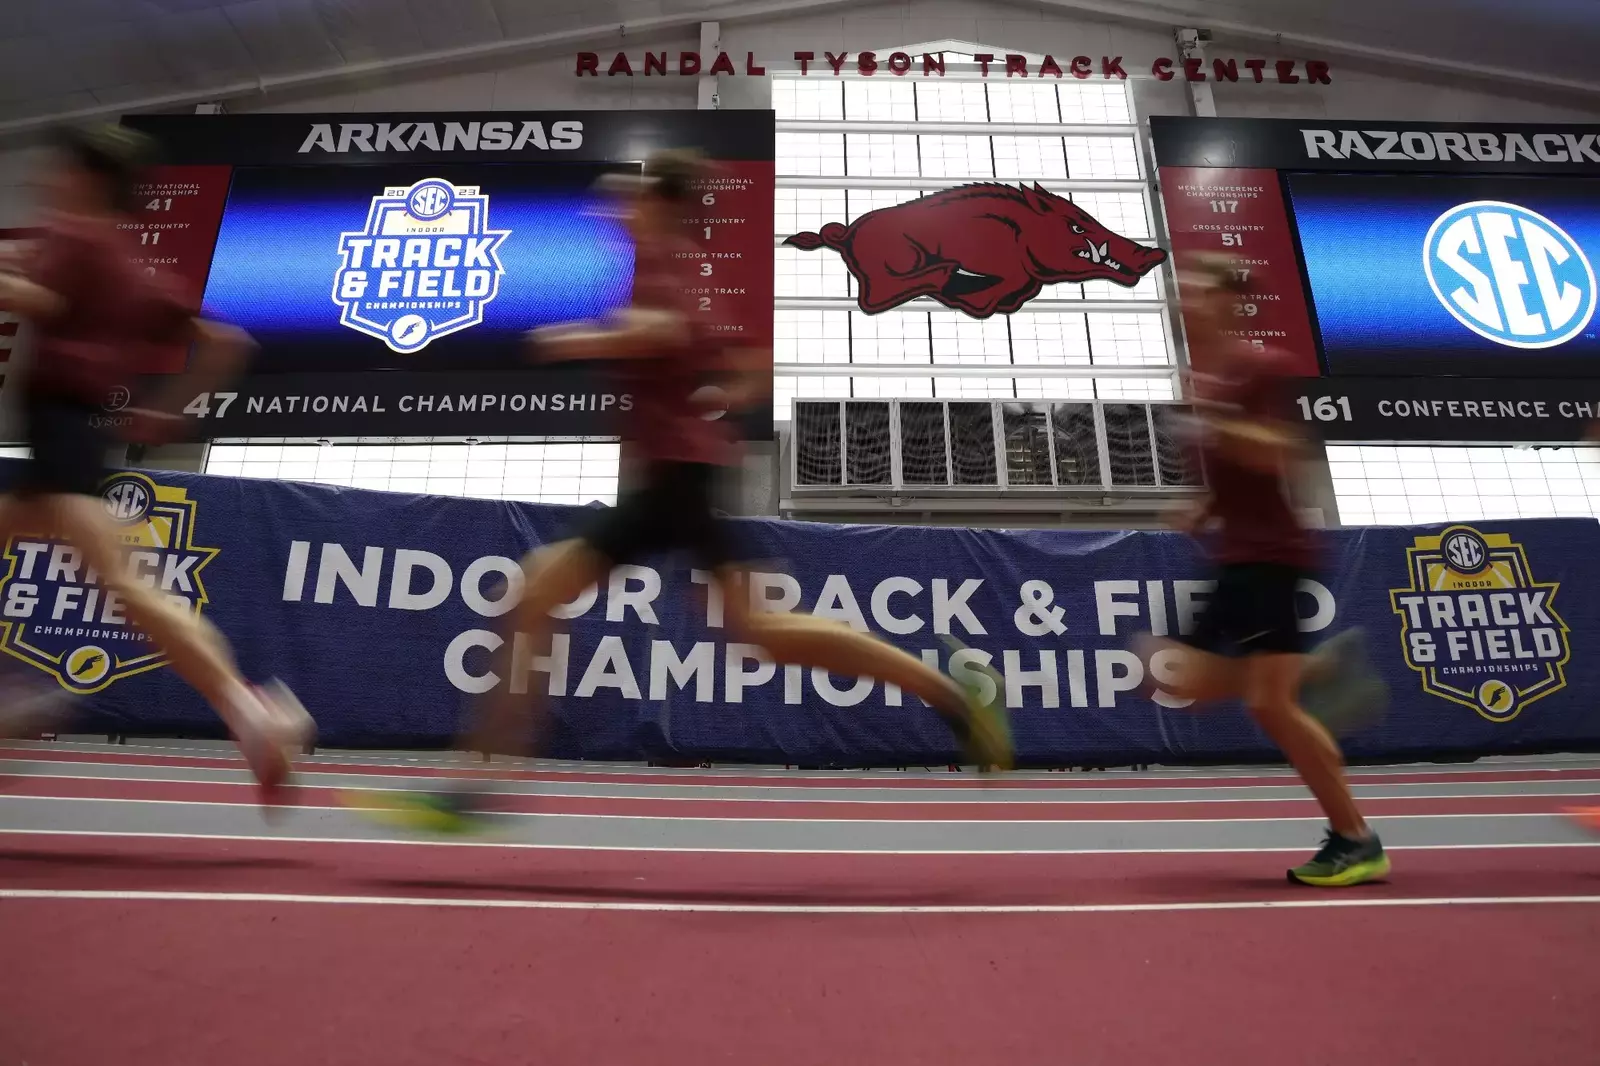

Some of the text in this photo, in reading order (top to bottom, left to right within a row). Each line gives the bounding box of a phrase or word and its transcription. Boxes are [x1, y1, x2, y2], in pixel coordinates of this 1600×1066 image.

[576, 51, 1332, 85] RANDAL TYSON TRACK CENTER
[297, 121, 584, 153] ARKANSAS
[1299, 129, 1600, 163] RAZORBACK
[145, 198, 173, 211] 41
[413, 187, 448, 215] SEC
[702, 193, 715, 206] 6
[1186, 191, 1258, 199] CHAMPIONSHIPS
[1209, 200, 1239, 214] 117
[140, 232, 160, 245] 11
[704, 226, 712, 240] 1
[1221, 233, 1243, 246] 51
[347, 237, 495, 268] TRACK
[700, 263, 713, 276] 3
[1436, 212, 1582, 336] SEC
[341, 270, 491, 298] & FIELD
[365, 301, 461, 309] CHAMPIONSHIPS
[698, 297, 711, 311] 2
[1232, 303, 1258, 317] 29
[183, 392, 634, 418] 47 NATIONAL CHAMPIONSHIPS
[1296, 396, 1600, 421] 161 CONFERENCE CH
[107, 483, 147, 518] SEC
[1448, 536, 1482, 567] SEC
[1453, 580, 1492, 588] INDOOR
[3, 583, 39, 617] &
[1014, 580, 1068, 636] &
[1094, 578, 1336, 637] FIED
[1400, 592, 1553, 628] TRACK
[1409, 627, 1561, 662] & FIELD
[1443, 664, 1539, 674] CHAMPIONSHIPS
